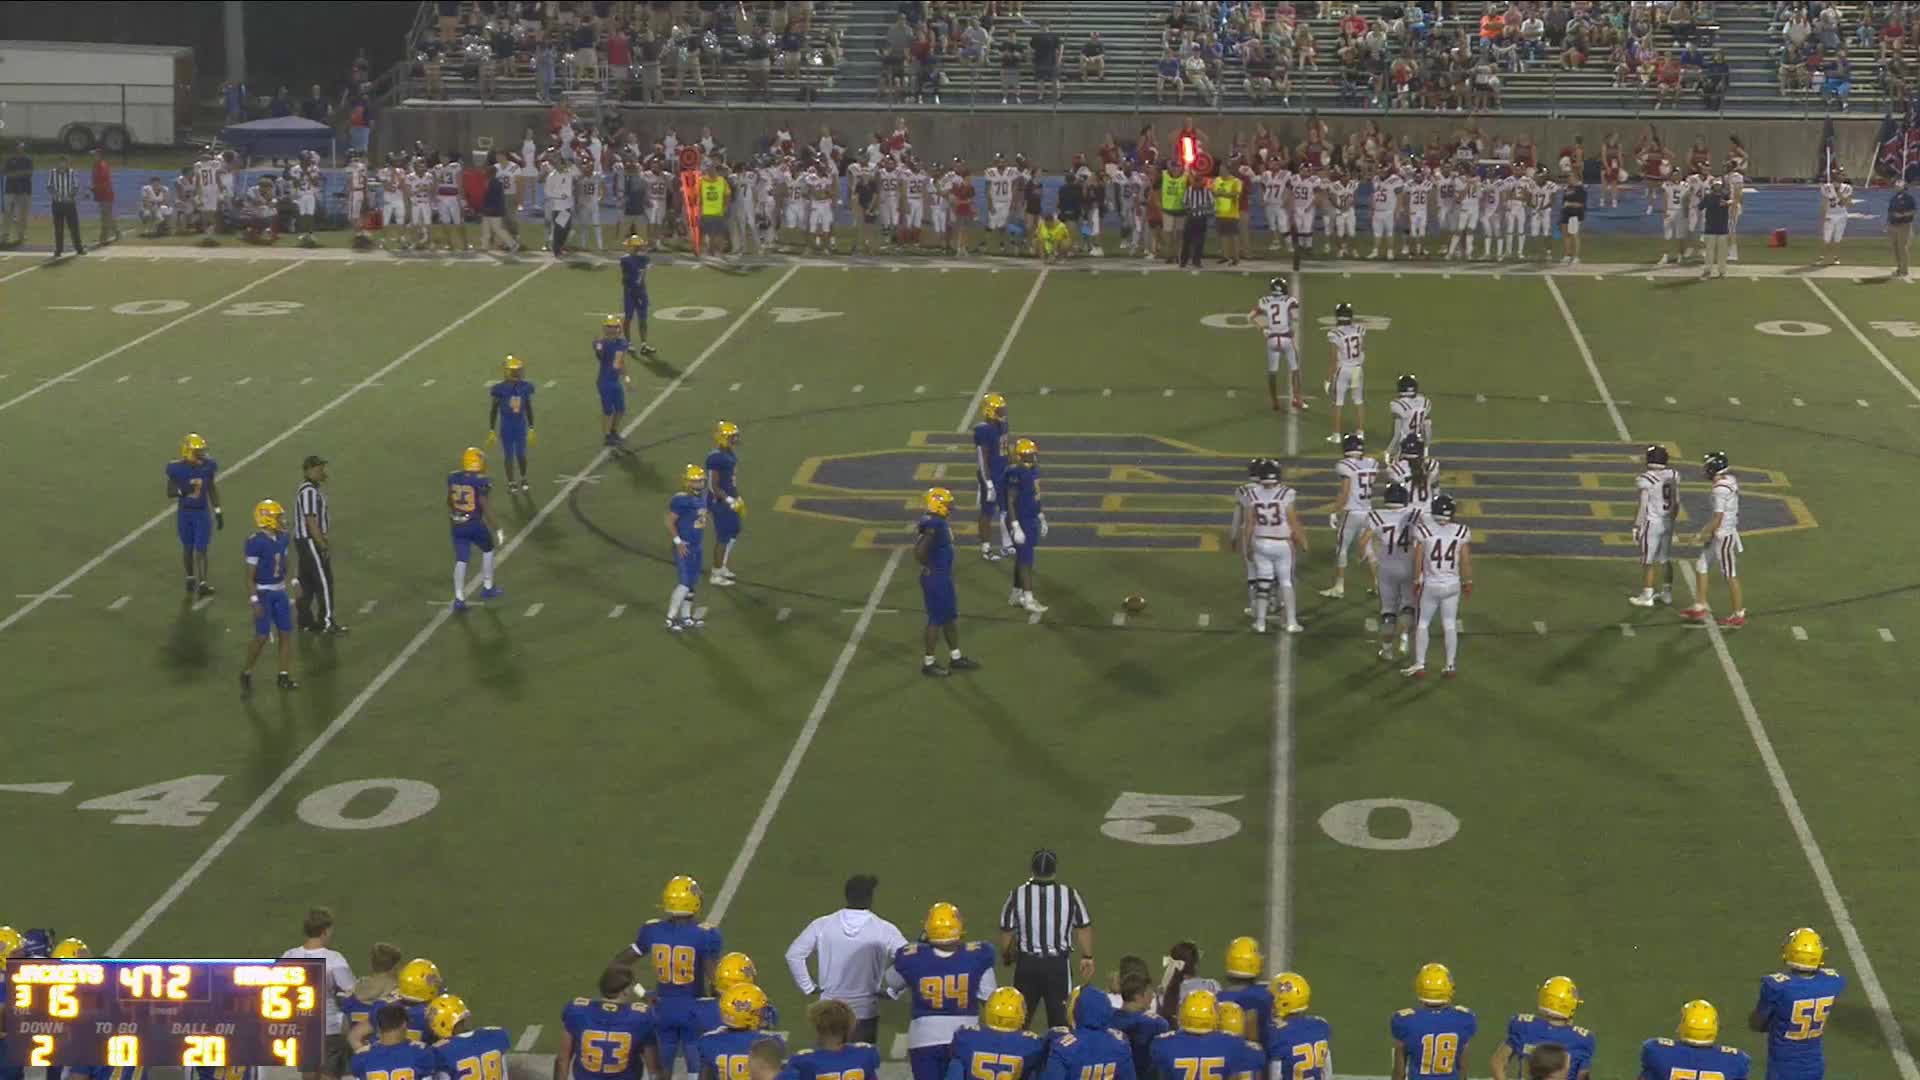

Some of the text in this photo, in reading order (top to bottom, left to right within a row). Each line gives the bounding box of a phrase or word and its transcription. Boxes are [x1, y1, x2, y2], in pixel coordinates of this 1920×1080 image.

[1269, 304, 1281, 325] 2
[1344, 335, 1361, 360] 13
[1661, 482, 1672, 511] 9
[1254, 503, 1281, 527] 63
[1382, 525, 1409, 555] 74
[1430, 538, 1458, 569] 44
[652, 944, 696, 985] 88
[920, 973, 969, 1009] 94
[1785, 996, 1834, 1040] 55
[581, 1030, 632, 1073] 63
[1420, 1033, 1458, 1074] 18
